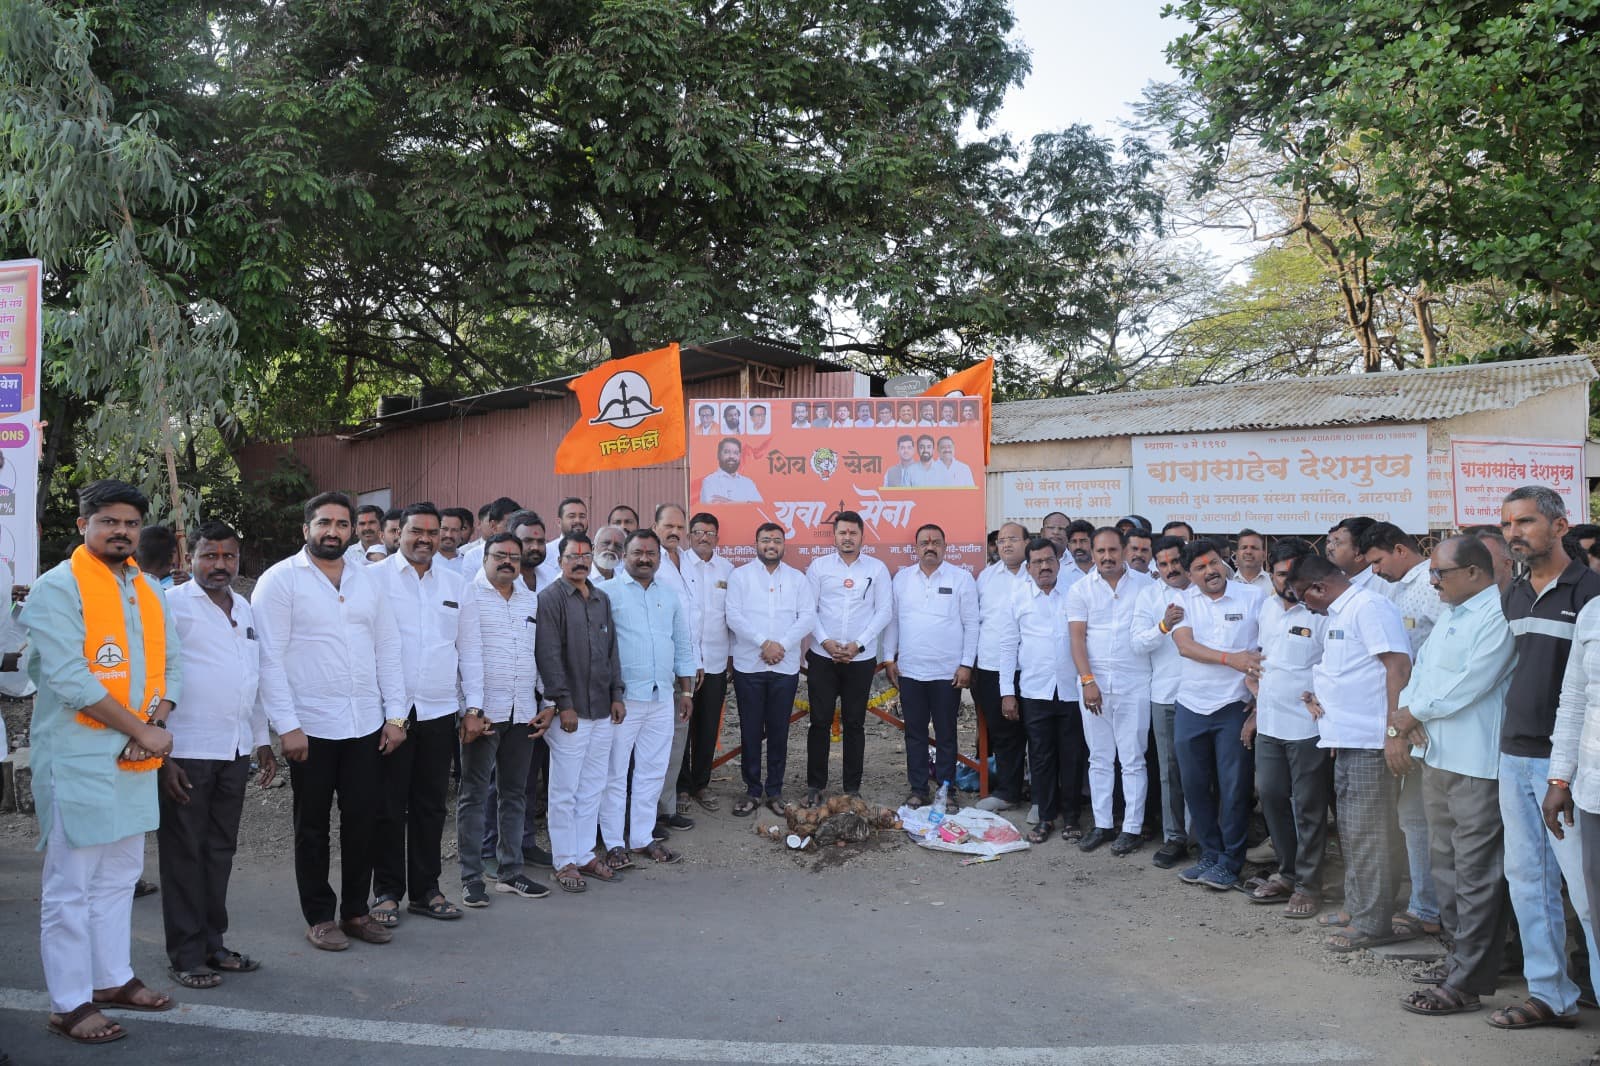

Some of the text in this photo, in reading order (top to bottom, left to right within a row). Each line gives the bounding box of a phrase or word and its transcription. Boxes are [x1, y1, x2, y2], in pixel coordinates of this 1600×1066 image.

[768, 451, 882, 475] शिव सेना
[1146, 451, 1290, 483] बाबासाहेब
[1298, 449, 1413, 487] देशमुख
[1461, 457, 1526, 481] बाबासाहेब
[1530, 459, 1574, 485] देशमुख
[1088, 492, 1112, 508] आहे
[757, 501, 826, 540] युवा
